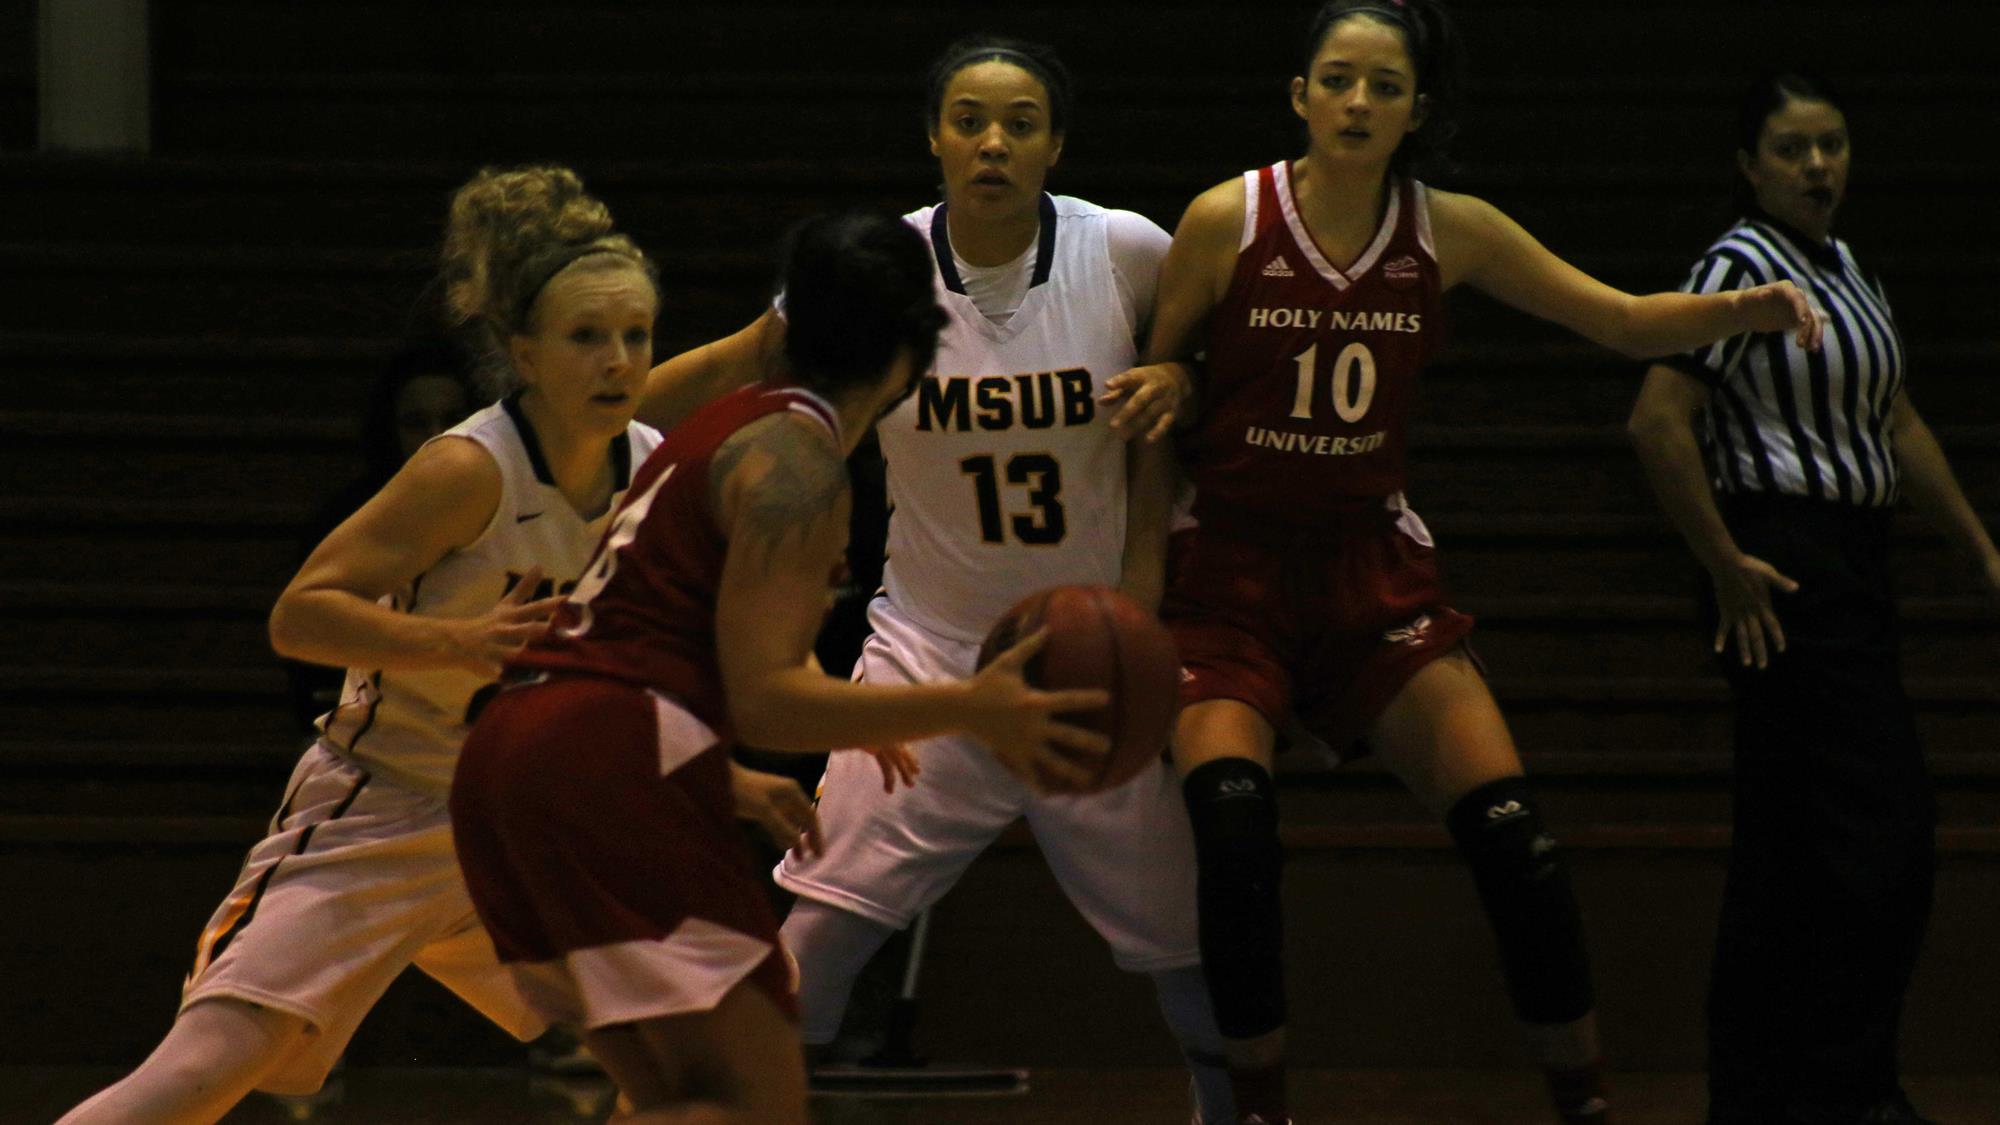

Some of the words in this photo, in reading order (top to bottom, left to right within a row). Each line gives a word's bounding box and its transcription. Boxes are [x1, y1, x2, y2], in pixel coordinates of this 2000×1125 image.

[1248, 308, 1322, 329] HOLY
[1329, 311, 1422, 333] NAMES
[916, 367, 1095, 432] MSUB
[1289, 341, 1377, 423] 10
[961, 453, 1067, 545] 13
